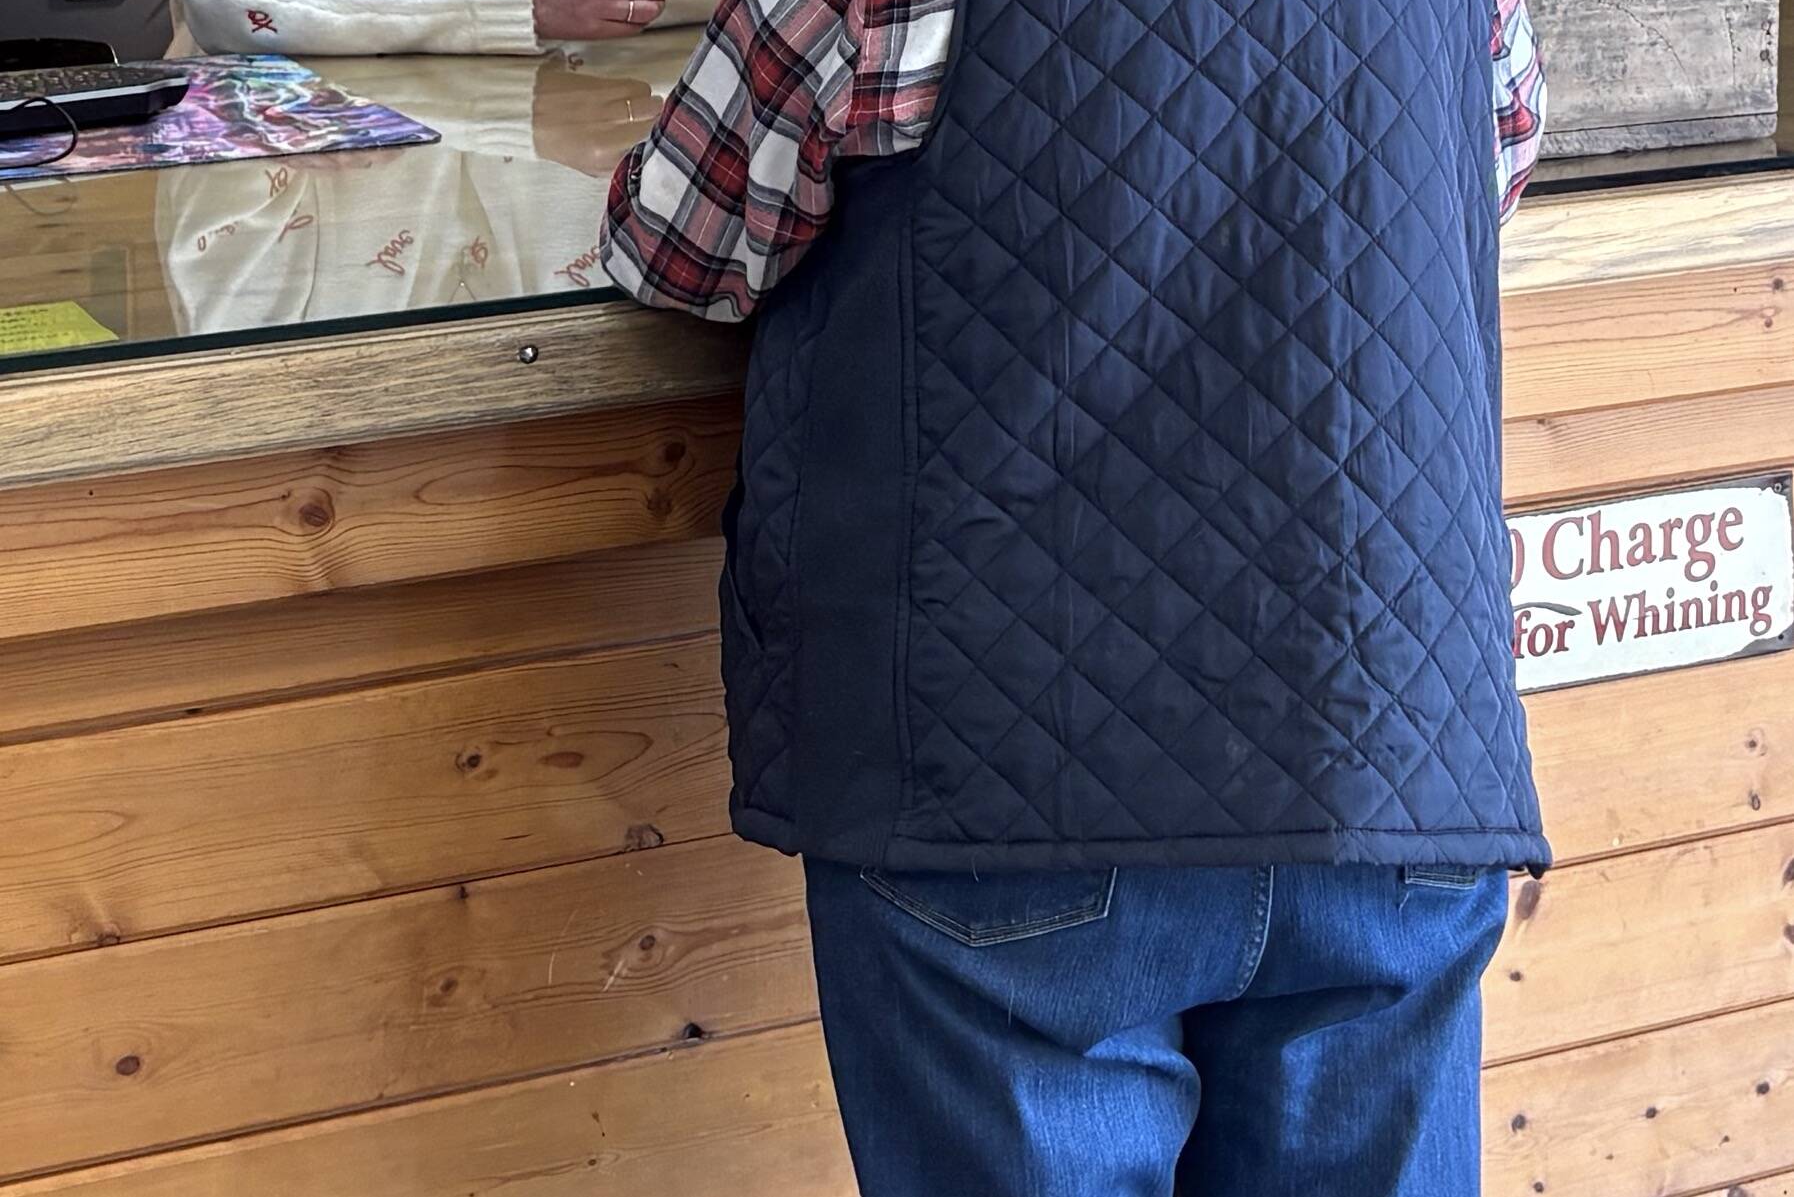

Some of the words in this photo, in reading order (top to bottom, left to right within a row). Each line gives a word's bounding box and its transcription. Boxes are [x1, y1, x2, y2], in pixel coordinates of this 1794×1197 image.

[1541, 506, 1745, 583] Charge
[1511, 609, 1577, 660] for
[1586, 579, 1774, 646] Whining
